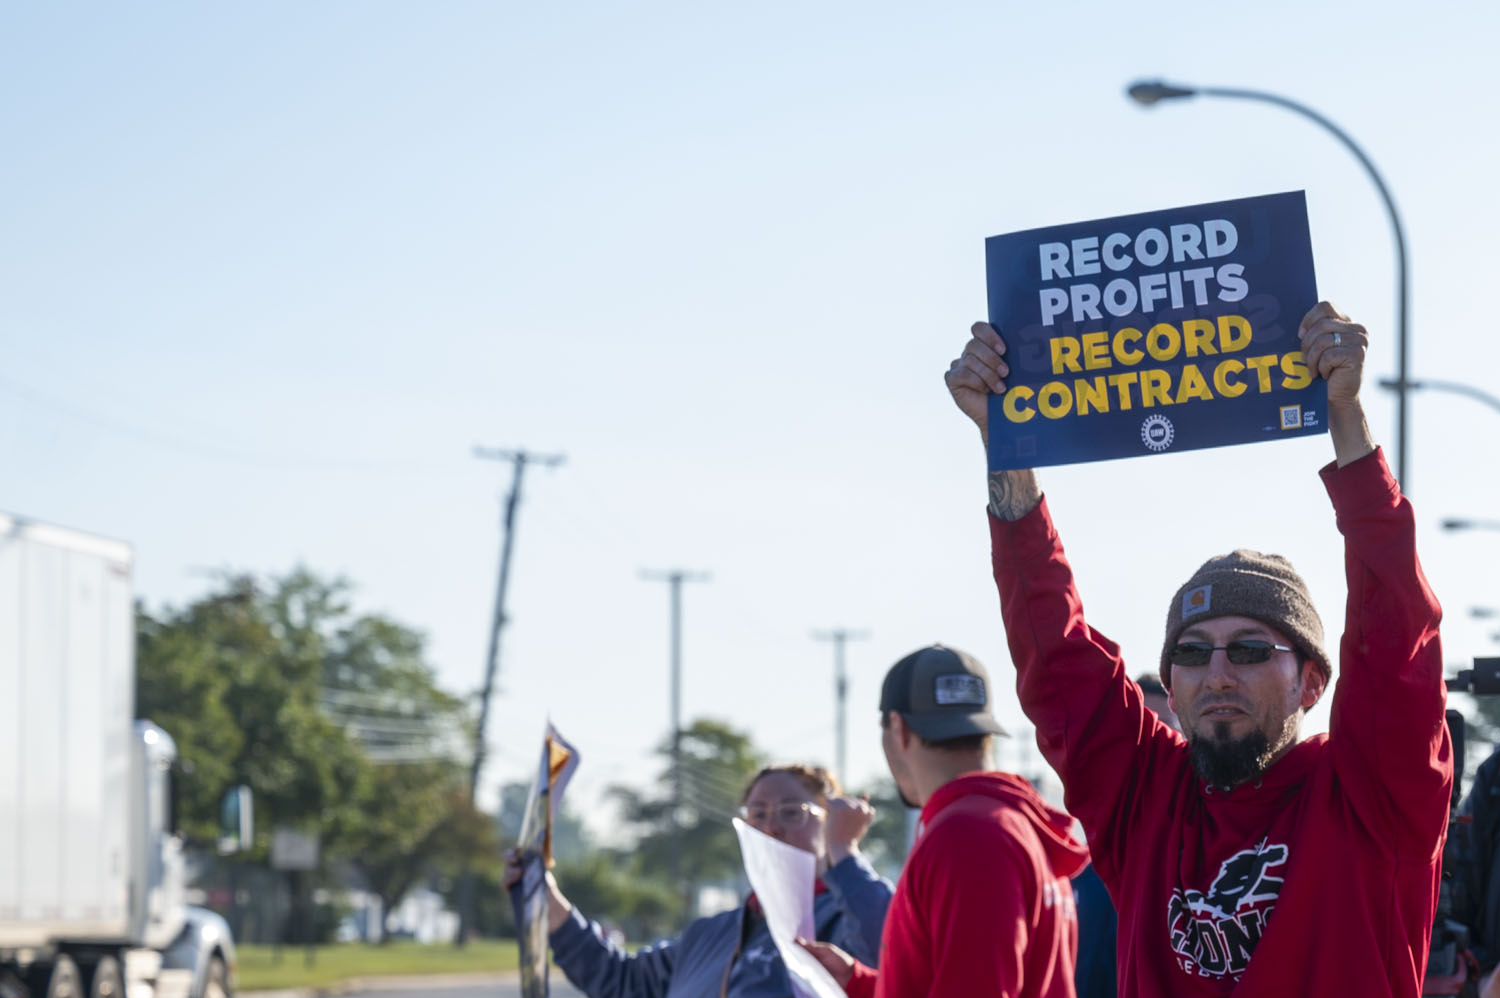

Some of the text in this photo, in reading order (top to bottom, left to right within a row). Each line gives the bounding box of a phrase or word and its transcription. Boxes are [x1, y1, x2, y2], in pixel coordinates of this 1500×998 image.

[1039, 219, 1239, 281] RECORD
[1040, 264, 1249, 326] PROFITS
[1050, 315, 1252, 375] RECORD
[1002, 351, 1313, 424] CONTRACTS
[1150, 428, 1164, 438] UAW
